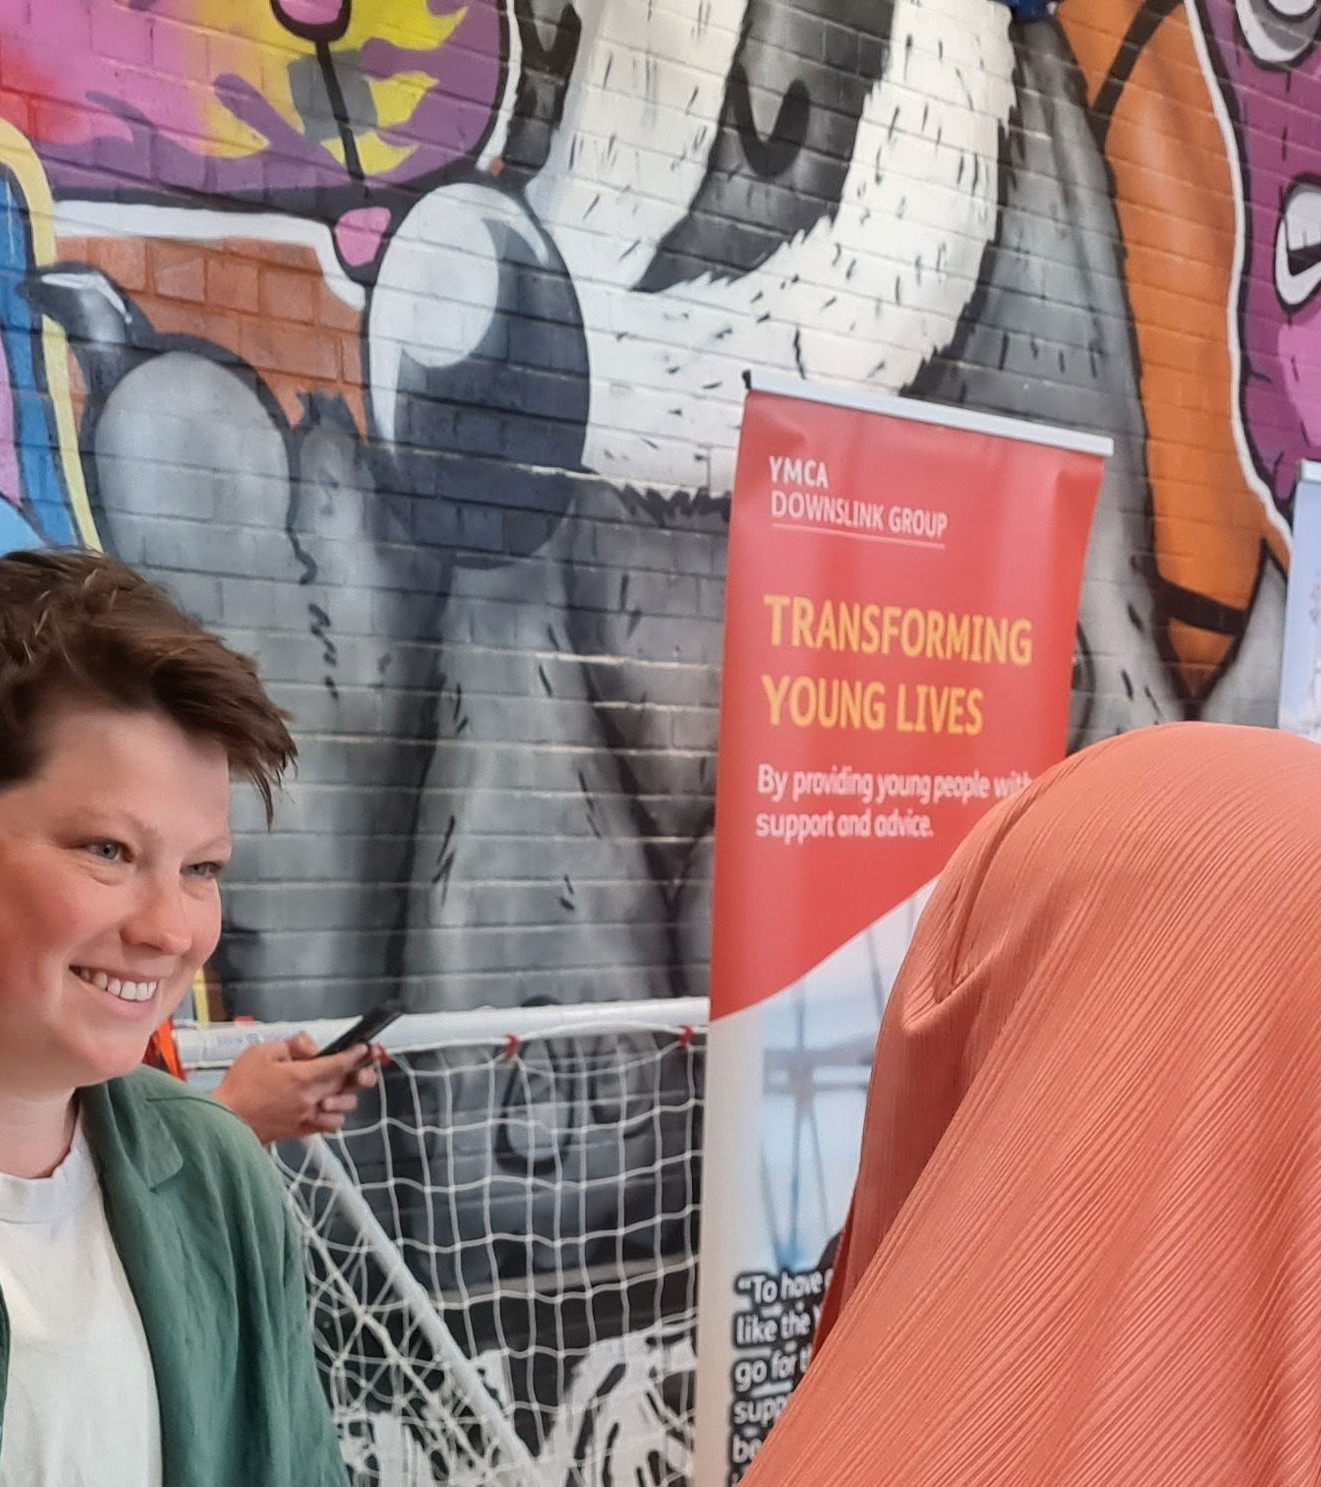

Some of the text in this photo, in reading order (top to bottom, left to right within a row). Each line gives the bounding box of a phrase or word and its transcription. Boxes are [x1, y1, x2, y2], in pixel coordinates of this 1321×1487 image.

[769, 455, 828, 489] YMCA
[770, 490, 949, 538] DOWNSLINK GROUP
[763, 594, 1033, 667] TRANSFORMING
[761, 674, 985, 737] YOUNG LIVES
[757, 762, 789, 802] By
[792, 764, 874, 805] providing
[874, 773, 931, 805] young
[932, 768, 991, 805] people
[755, 807, 935, 846] support and advice.
[780, 1270, 824, 1301] have
[736, 1313, 779, 1344] like
[780, 1309, 811, 1340] the
[733, 1359, 769, 1393] go
[771, 1349, 798, 1380] for
